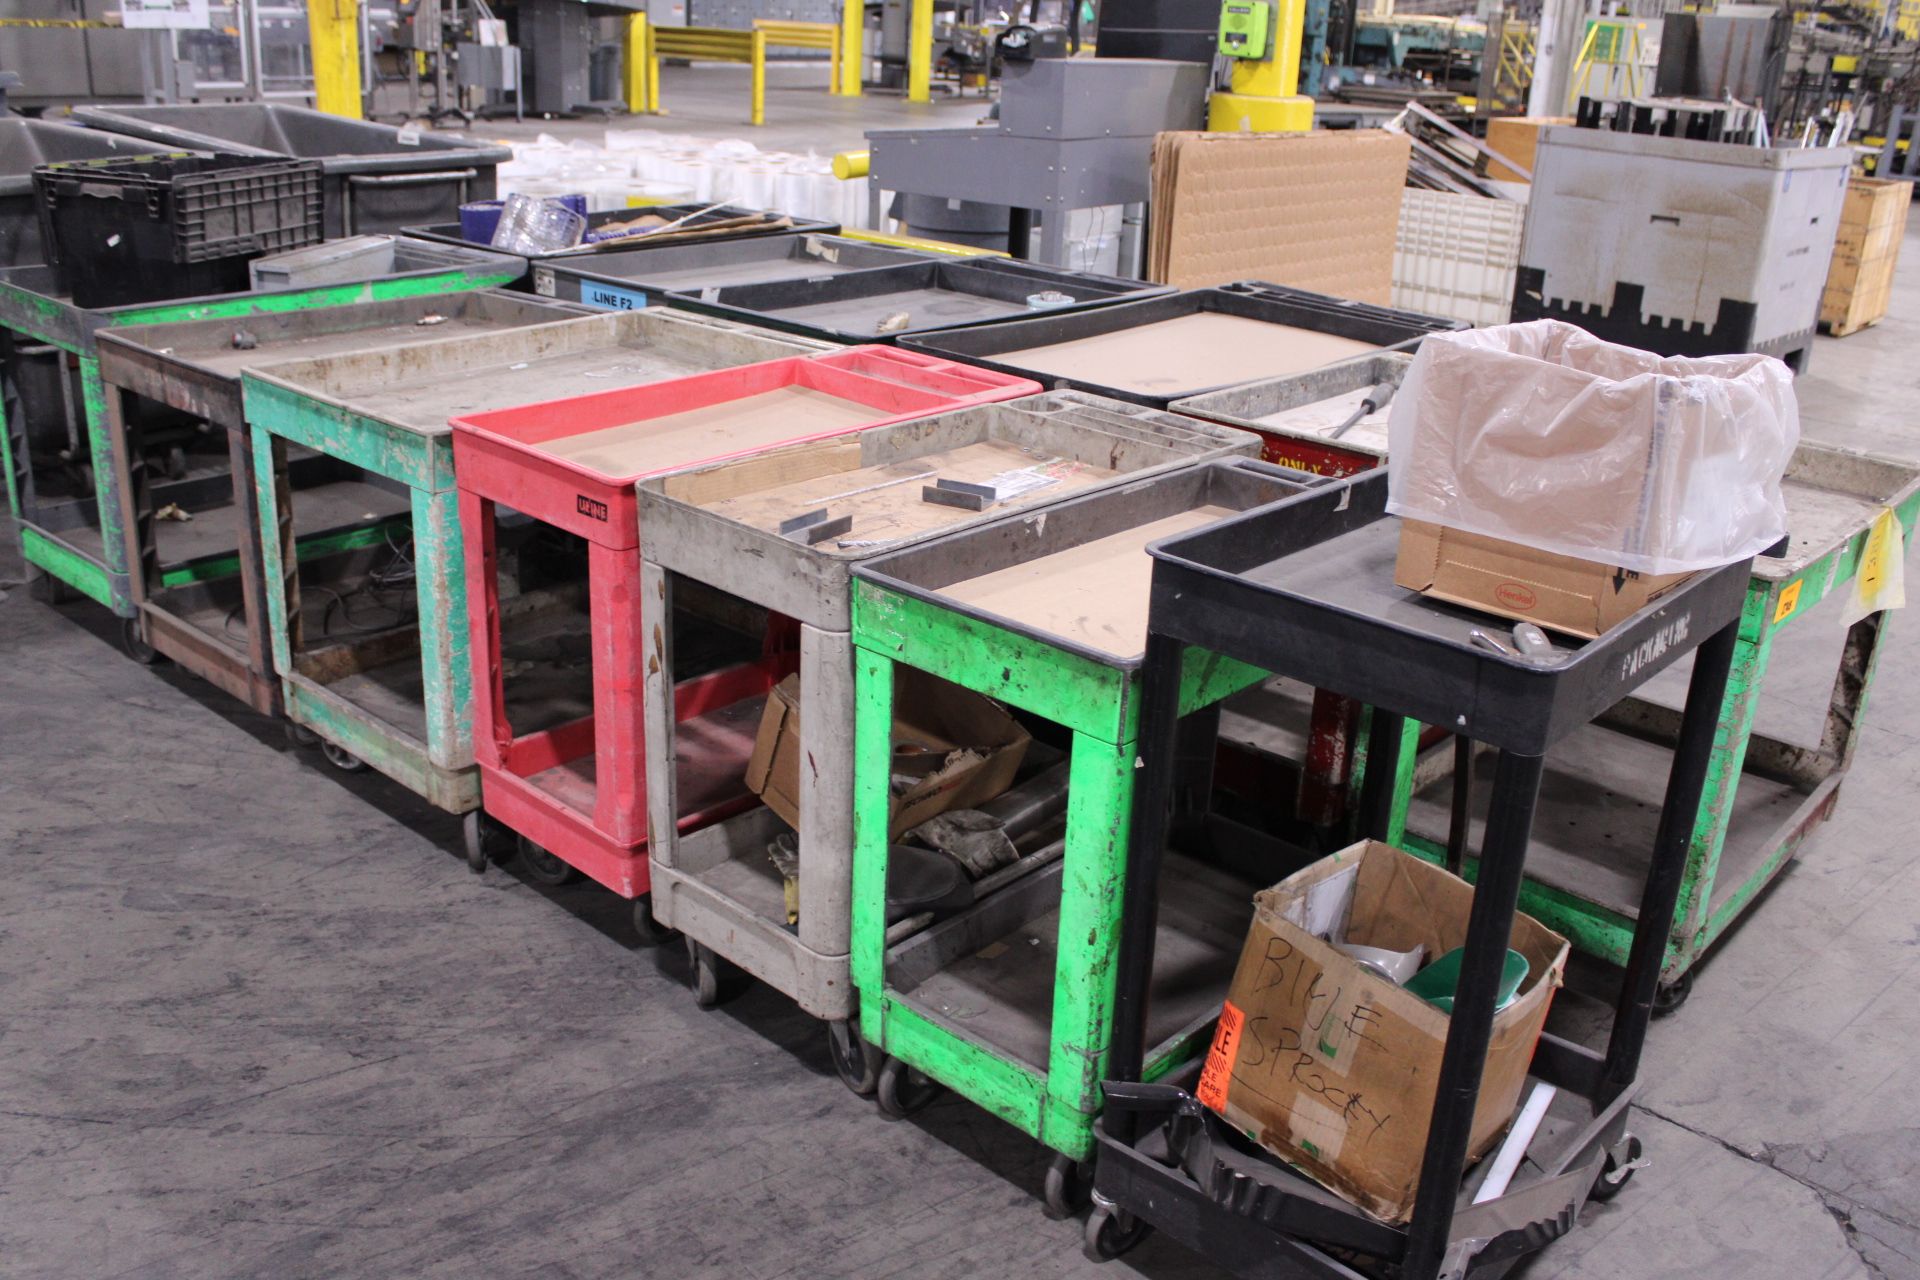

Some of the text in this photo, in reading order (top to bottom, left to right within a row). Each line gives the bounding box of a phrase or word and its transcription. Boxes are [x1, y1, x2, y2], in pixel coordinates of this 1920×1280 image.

[593, 291, 633, 311] LINE F2
[1499, 588, 1533, 605] Henkel
